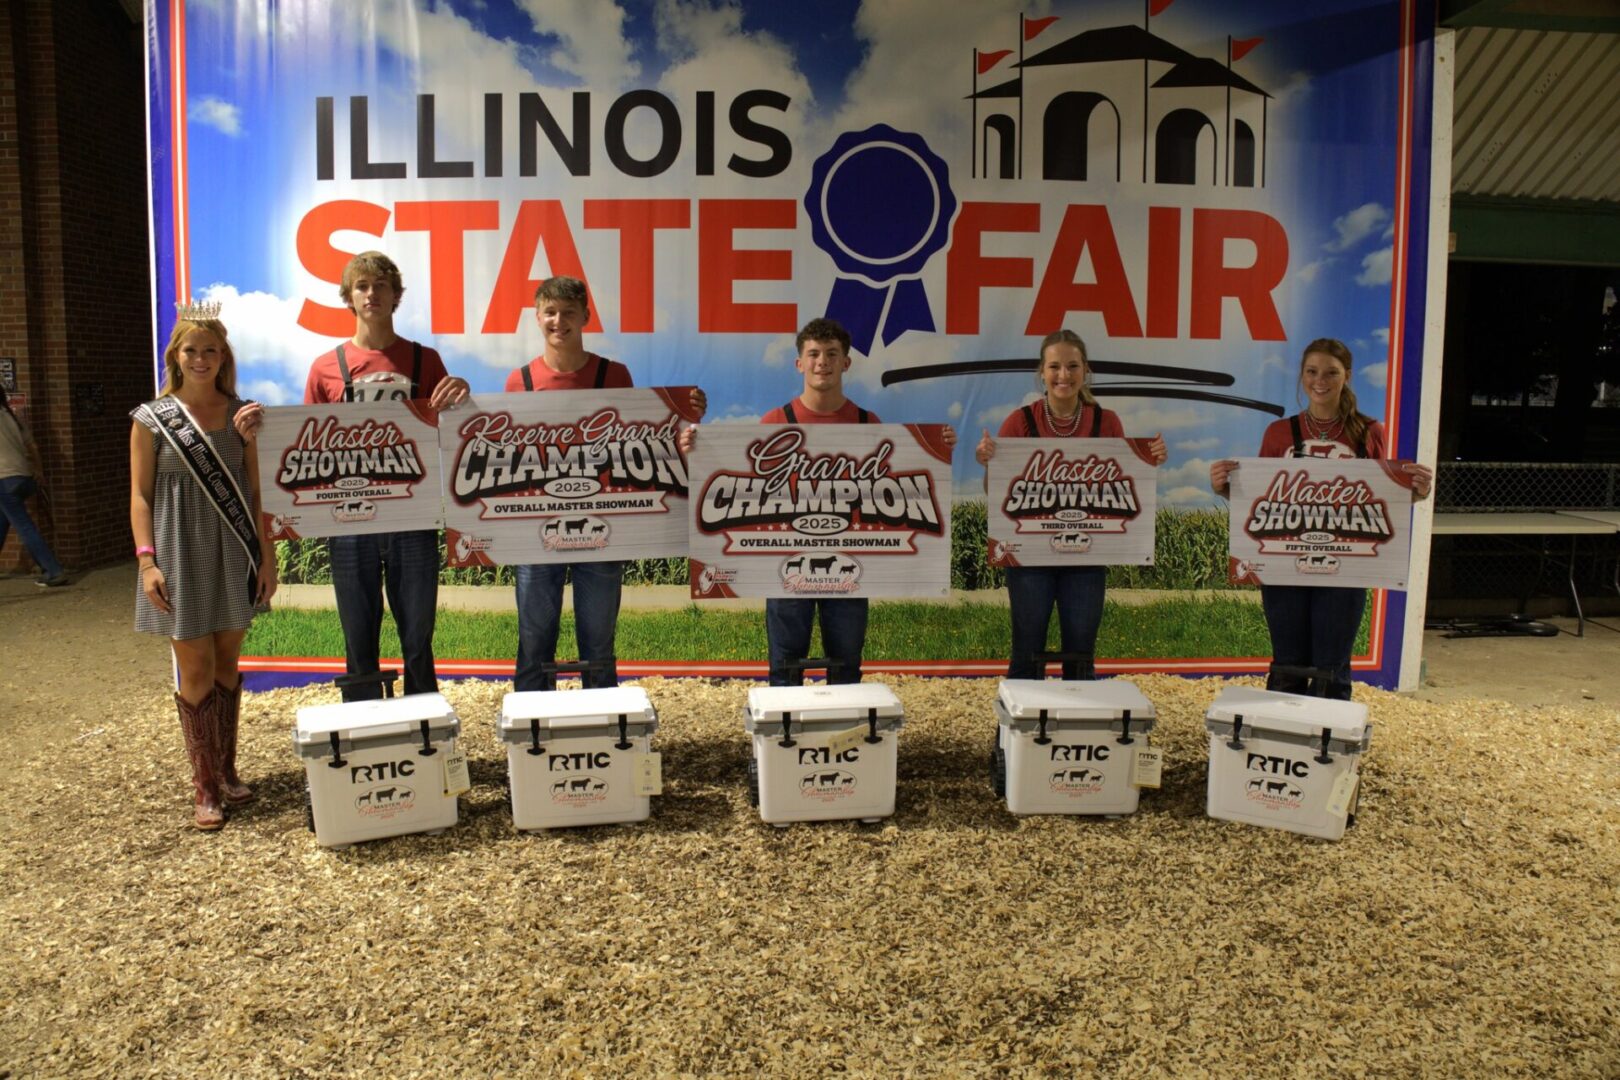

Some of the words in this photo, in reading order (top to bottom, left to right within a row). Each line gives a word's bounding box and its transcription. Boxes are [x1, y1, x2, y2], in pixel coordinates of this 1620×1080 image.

[316, 89, 793, 181] ILLINOIS
[296, 199, 798, 338] STATE
[946, 202, 1290, 341] FAIR
[298, 418, 400, 451] Master
[461, 414, 577, 452] Reserve
[580, 410, 679, 455] Grand
[175, 425, 195, 447] Miss
[189, 443, 213, 475] Illinois
[207, 471, 230, 503] County
[279, 443, 424, 486] SHOWMAN
[454, 435, 689, 497] CHAMPION
[750, 430, 891, 493] Grand
[1025, 452, 1120, 482] Master
[316, 491, 351, 500] FOURTH
[352, 488, 392, 498] OVERALL
[340, 478, 365, 487] 2025
[554, 481, 591, 492] 2025
[1268, 472, 1371, 505] Master
[494, 503, 546, 514] OVERALL
[547, 501, 594, 513] MASTER
[595, 498, 654, 510] SHOWMAN
[701, 473, 940, 525] CHAMPION
[1005, 479, 1138, 512] SHOWMAN
[799, 517, 841, 530] 2025
[1041, 522, 1066, 530] THIRD
[1067, 522, 1104, 530] OVERALL
[1060, 511, 1083, 519] 2025
[1248, 500, 1391, 536] SHOWMAN
[740, 538, 792, 548] OVERALL
[793, 538, 842, 548] MASTER
[842, 538, 901, 548] SHOWMAN
[1306, 533, 1330, 541] 2025
[1312, 544, 1353, 552] OVERALL
[549, 752, 611, 771] RTIC
[799, 747, 859, 765] RTIC
[1051, 745, 1111, 762] RTIC
[1246, 752, 1310, 778] RTIC
[351, 760, 415, 784] RTIC
